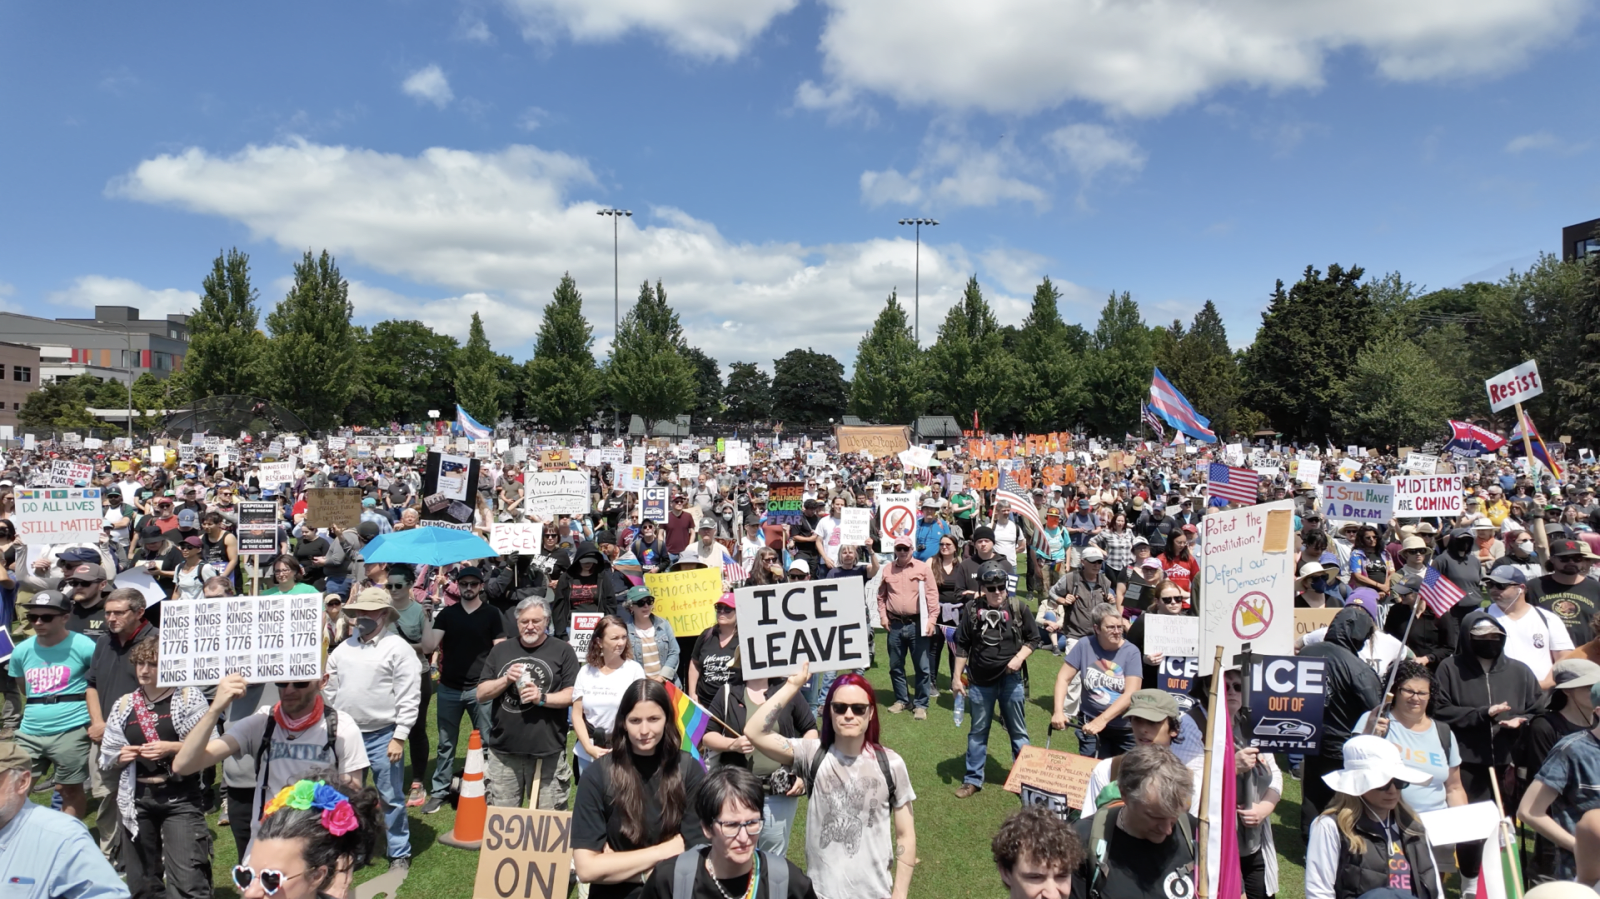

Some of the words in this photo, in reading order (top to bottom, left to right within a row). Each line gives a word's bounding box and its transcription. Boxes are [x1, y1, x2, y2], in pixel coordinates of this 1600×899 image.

[1489, 371, 1538, 405] Resist
[845, 436, 860, 446] We
[873, 435, 904, 451] People
[968, 439, 1015, 460] NAZI
[54, 461, 70, 469] FUCK
[53, 468, 68, 476] FUCK
[69, 470, 88, 478] ICE
[51, 476, 66, 484] FUCK
[535, 475, 557, 486] Proud
[1397, 477, 1462, 494] MIDTERMS
[644, 489, 664, 500] ICE
[770, 487, 804, 496] HERE
[1326, 485, 1334, 499] I
[1337, 487, 1364, 501] STILL
[1366, 489, 1389, 504] HAVE
[22, 502, 38, 513] DO
[42, 502, 62, 511] ALL
[66, 501, 95, 511] LIVES
[768, 501, 803, 511] QUEER
[1398, 500, 1413, 510] ARE
[1415, 496, 1460, 511] COMING
[1327, 503, 1337, 516] A
[1343, 504, 1382, 519] DREAM
[22, 521, 58, 534] STILL
[60, 518, 103, 532] MATTER
[768, 516, 802, 525] FEAR
[1205, 516, 1237, 536] Protect
[1246, 512, 1262, 528] the
[495, 525, 532, 537] FUCK
[498, 535, 536, 550] ICE!
[1204, 527, 1262, 555] Constitution!
[1206, 557, 1243, 585] Defend
[1249, 557, 1268, 569] our
[650, 572, 697, 583] DEFEND
[195, 603, 206, 614] NO
[227, 601, 238, 612] NO
[259, 600, 270, 610] NO
[290, 598, 302, 609] NO
[753, 584, 838, 626] ICE
[164, 606, 175, 616] NO
[258, 610, 285, 622] KINGS
[290, 609, 317, 620] KINGS
[163, 616, 189, 628] KINGS
[194, 614, 221, 626] KINGS
[226, 612, 253, 623] KINGS
[90, 620, 103, 629] W
[226, 624, 252, 635] SINCE
[258, 622, 284, 634] SINCE
[290, 621, 316, 632] SINCE
[163, 628, 189, 640] SINCE
[194, 626, 220, 637] SINCE
[194, 638, 220, 652] 1776
[225, 636, 251, 650] 1776
[258, 634, 284, 649] 1776
[290, 633, 316, 647] 1776
[162, 640, 188, 655] 1776
[748, 623, 862, 670] LEAVE
[161, 659, 172, 670] NO
[193, 657, 205, 668] NO
[225, 656, 236, 666] NO
[257, 654, 269, 664] NO
[289, 653, 301, 664] NO
[257, 664, 284, 677] KINGS
[289, 663, 316, 676] KINGS
[1159, 656, 1198, 679] ICE
[161, 670, 187, 682] KINGS
[193, 668, 220, 680] KINGS
[1252, 659, 1325, 694] ICE
[1168, 678, 1180, 688] OUT
[1181, 679, 1189, 690] OF
[1268, 697, 1290, 712] OUT
[1293, 697, 1305, 712] OF
[1250, 738, 1316, 749] SEATTLE
[1395, 743, 1443, 767] ISE
[486, 814, 571, 853] KINGS
[494, 857, 556, 899] NO
